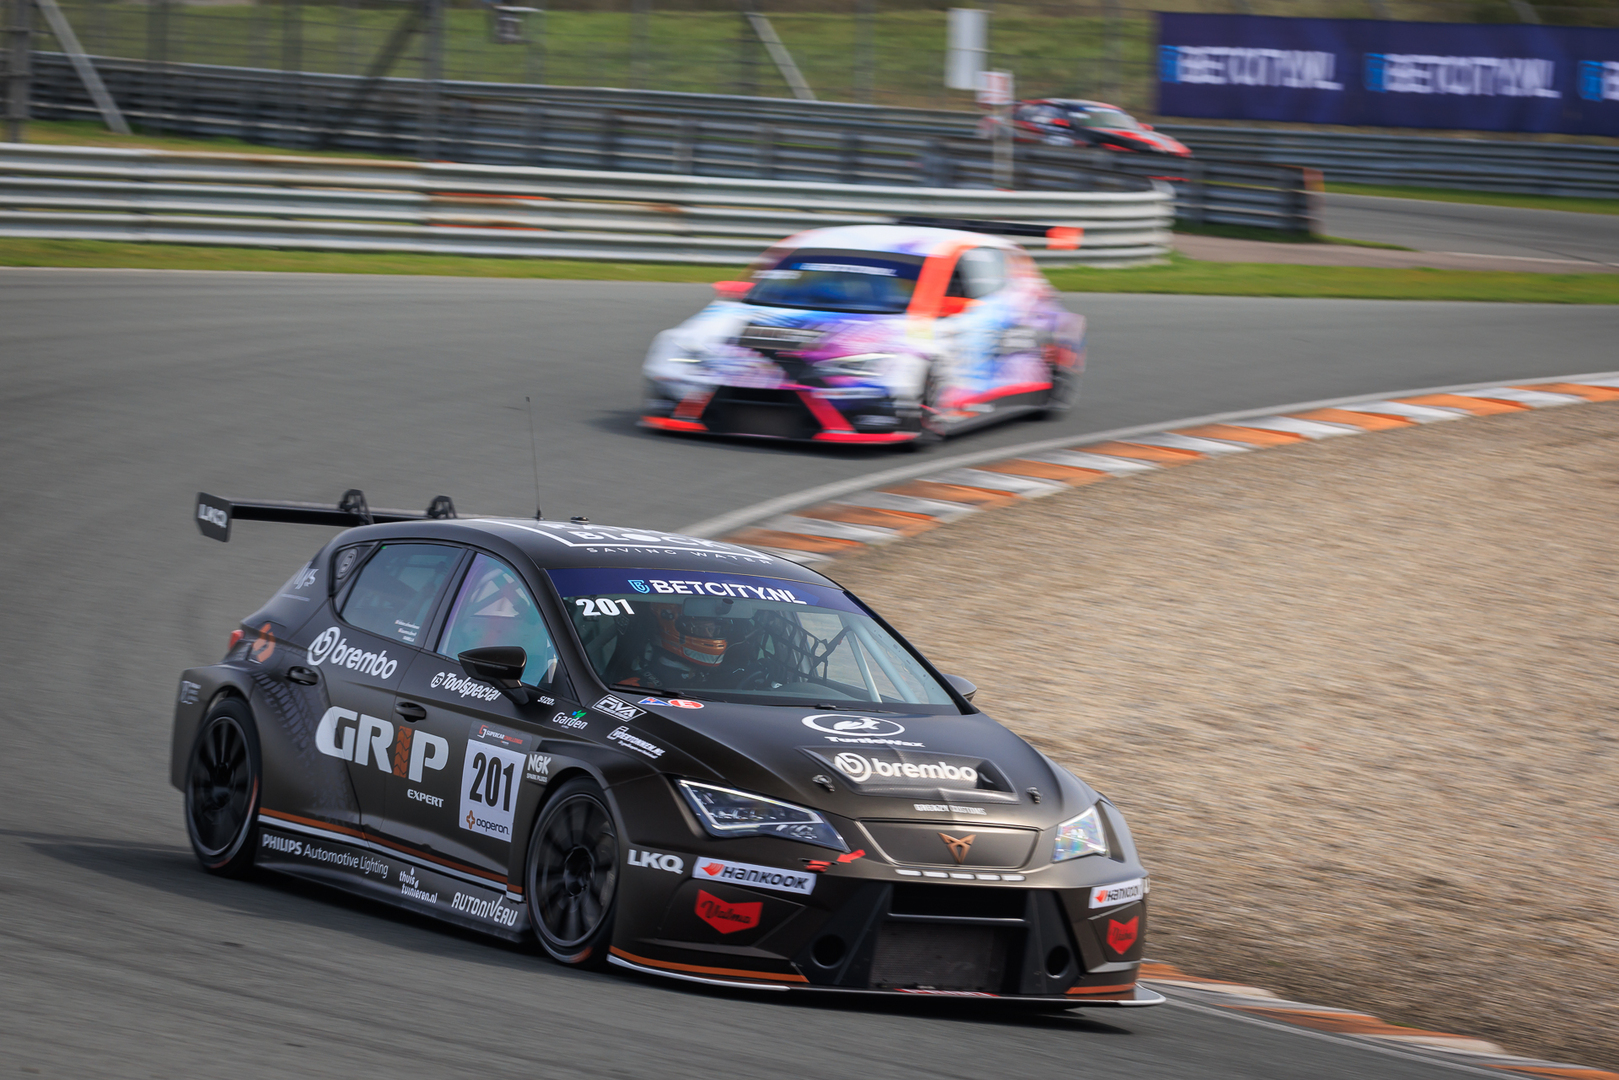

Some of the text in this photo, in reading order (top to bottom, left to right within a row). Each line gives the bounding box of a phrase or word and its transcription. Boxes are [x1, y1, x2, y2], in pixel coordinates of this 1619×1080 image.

[586, 547, 677, 555] SAVING
[650, 579, 807, 605] BETCITY.NL
[576, 598, 635, 617] 201
[330, 637, 398, 679] brembo
[552, 711, 589, 730] Garden
[315, 705, 449, 783] GRIP
[527, 753, 552, 775] NGK
[870, 758, 978, 782] brembo
[469, 752, 515, 812] 201
[406, 788, 444, 808] EXPERT
[262, 833, 389, 879] PHILIPS Automotive Lighting
[627, 849, 684, 875] LKQ
[451, 892, 518, 927] AUTONIVEAU
